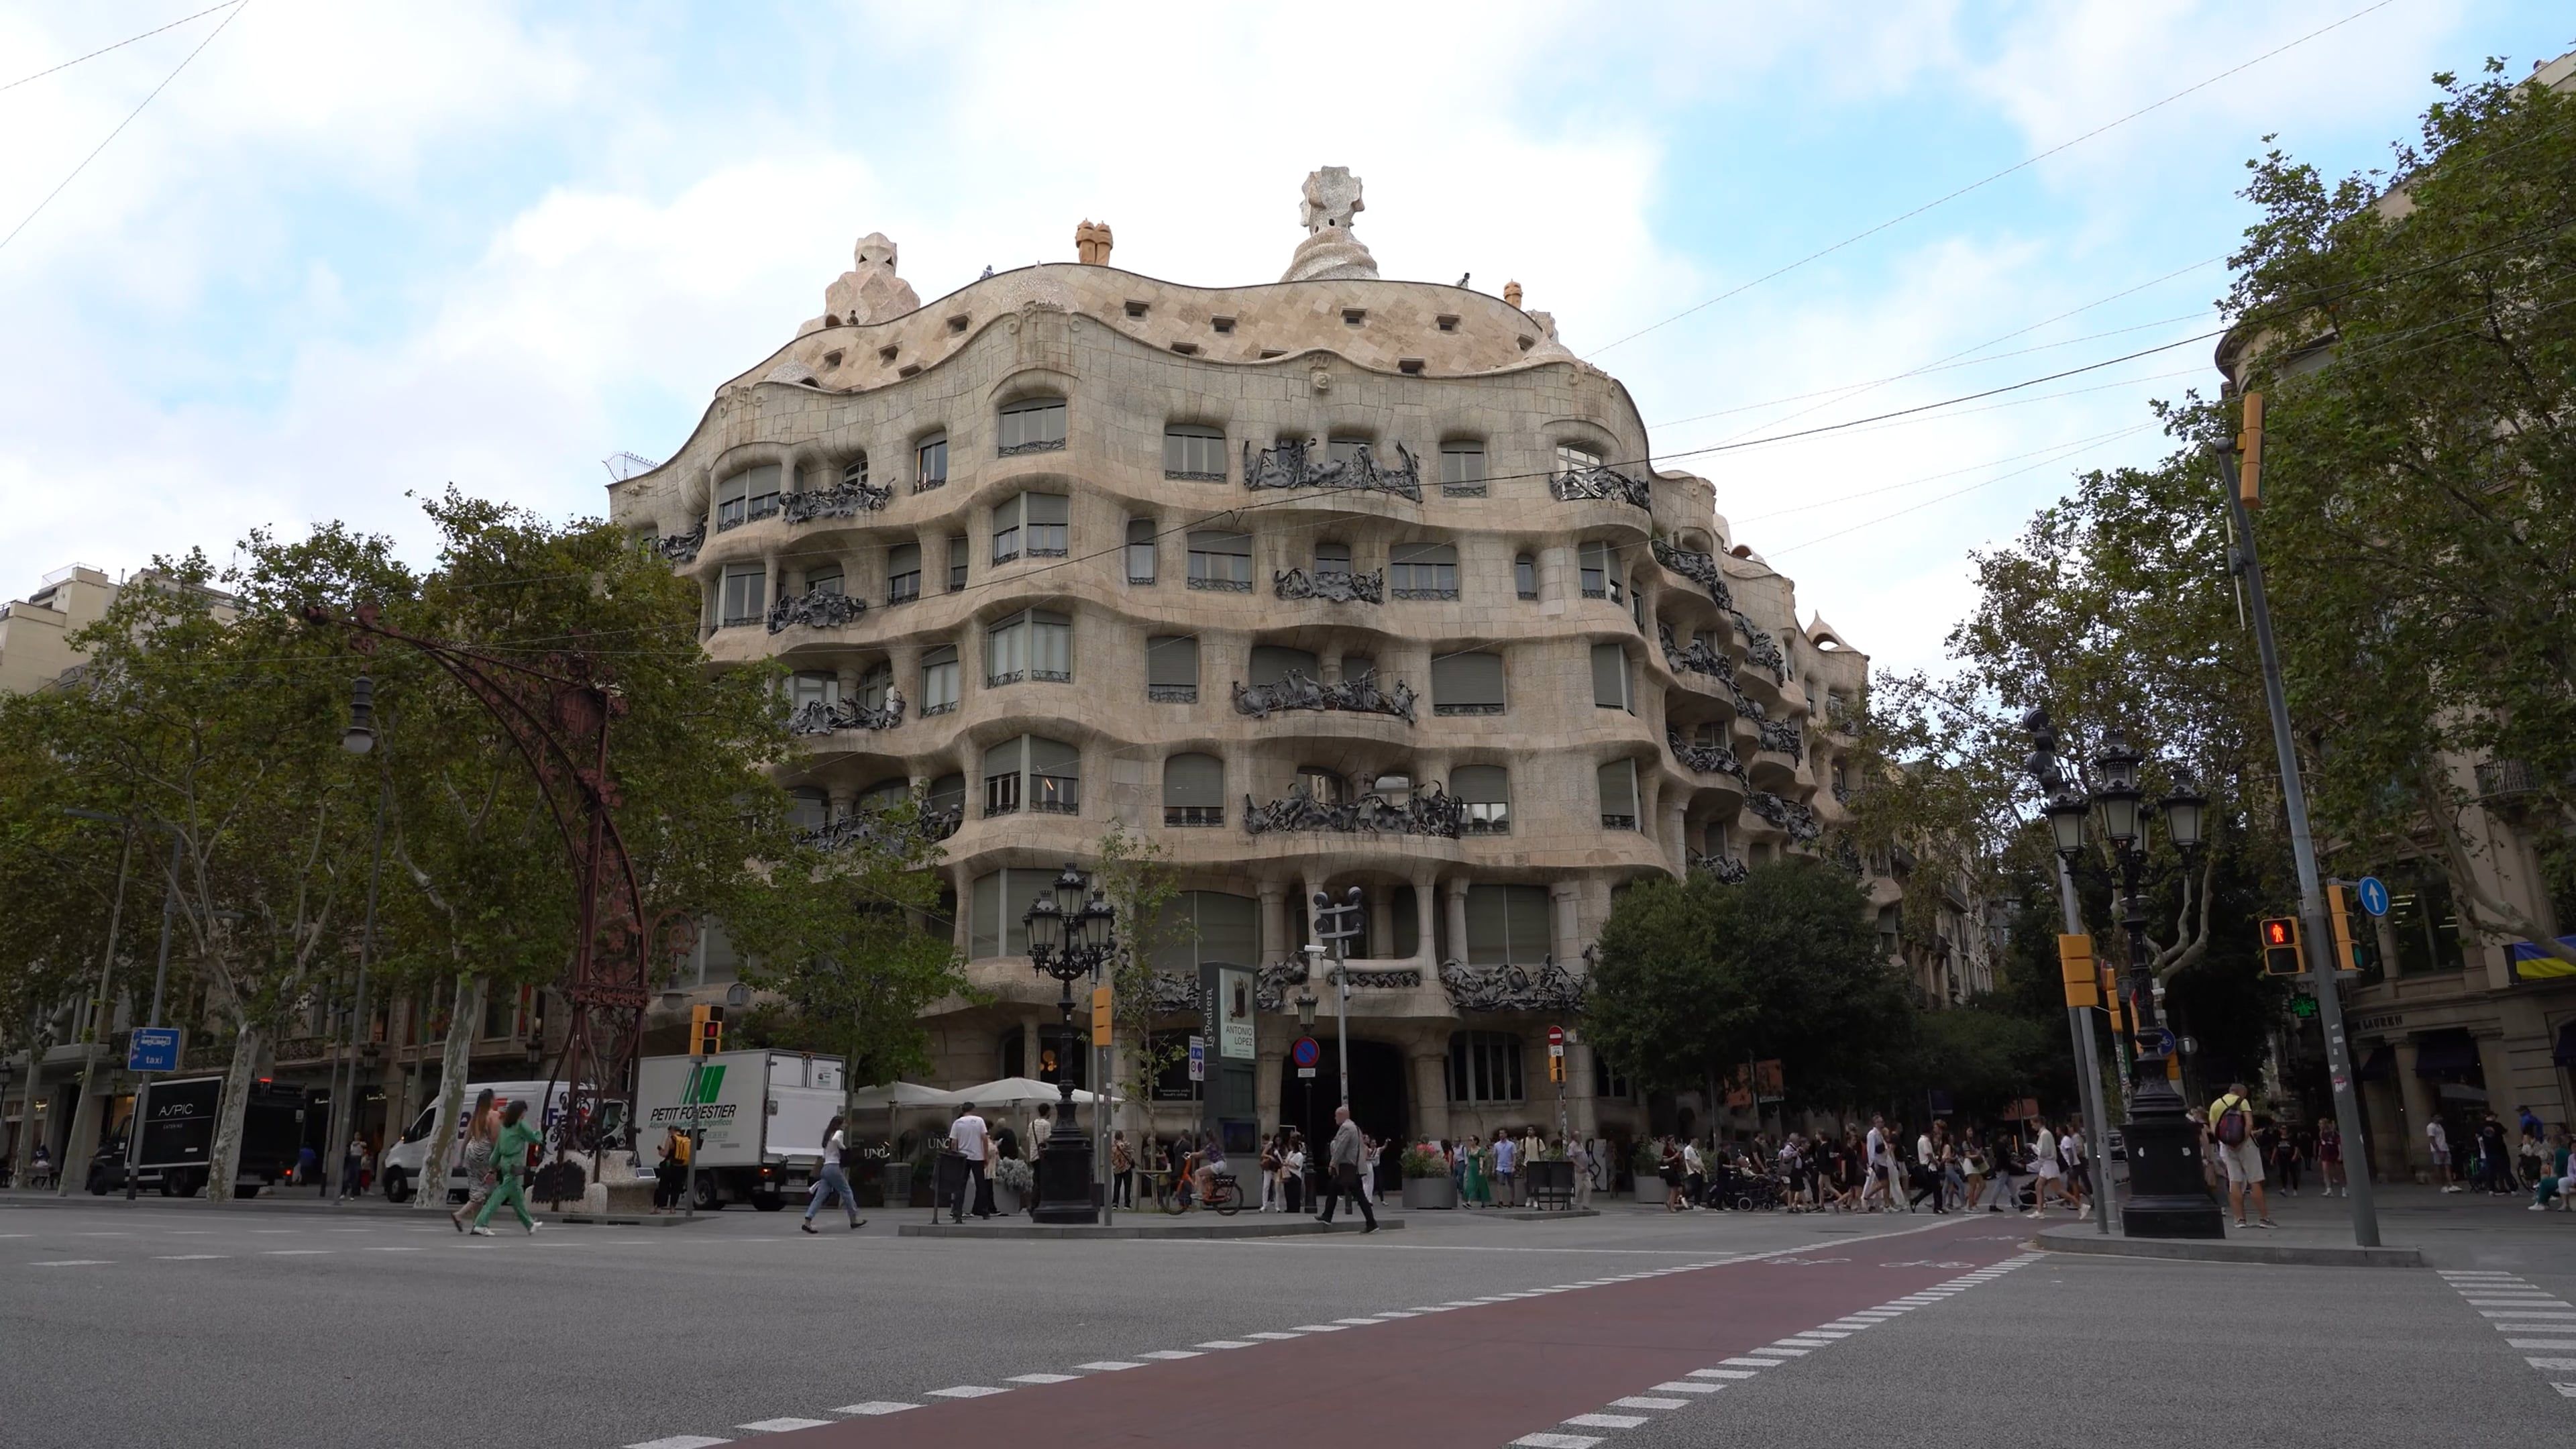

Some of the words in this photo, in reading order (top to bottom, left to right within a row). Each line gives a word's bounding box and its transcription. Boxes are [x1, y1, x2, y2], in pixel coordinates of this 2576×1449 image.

[1204, 987, 1213, 1034] Pedrera
[2363, 1015, 2403, 1030] LAUREN
[1226, 1026, 1252, 1036] ANTONIO
[146, 1055, 163, 1064] taxi
[158, 1104, 194, 1116] ASPIC
[650, 1108, 680, 1121] PETIT
[680, 1105, 737, 1120] FOESTIER
